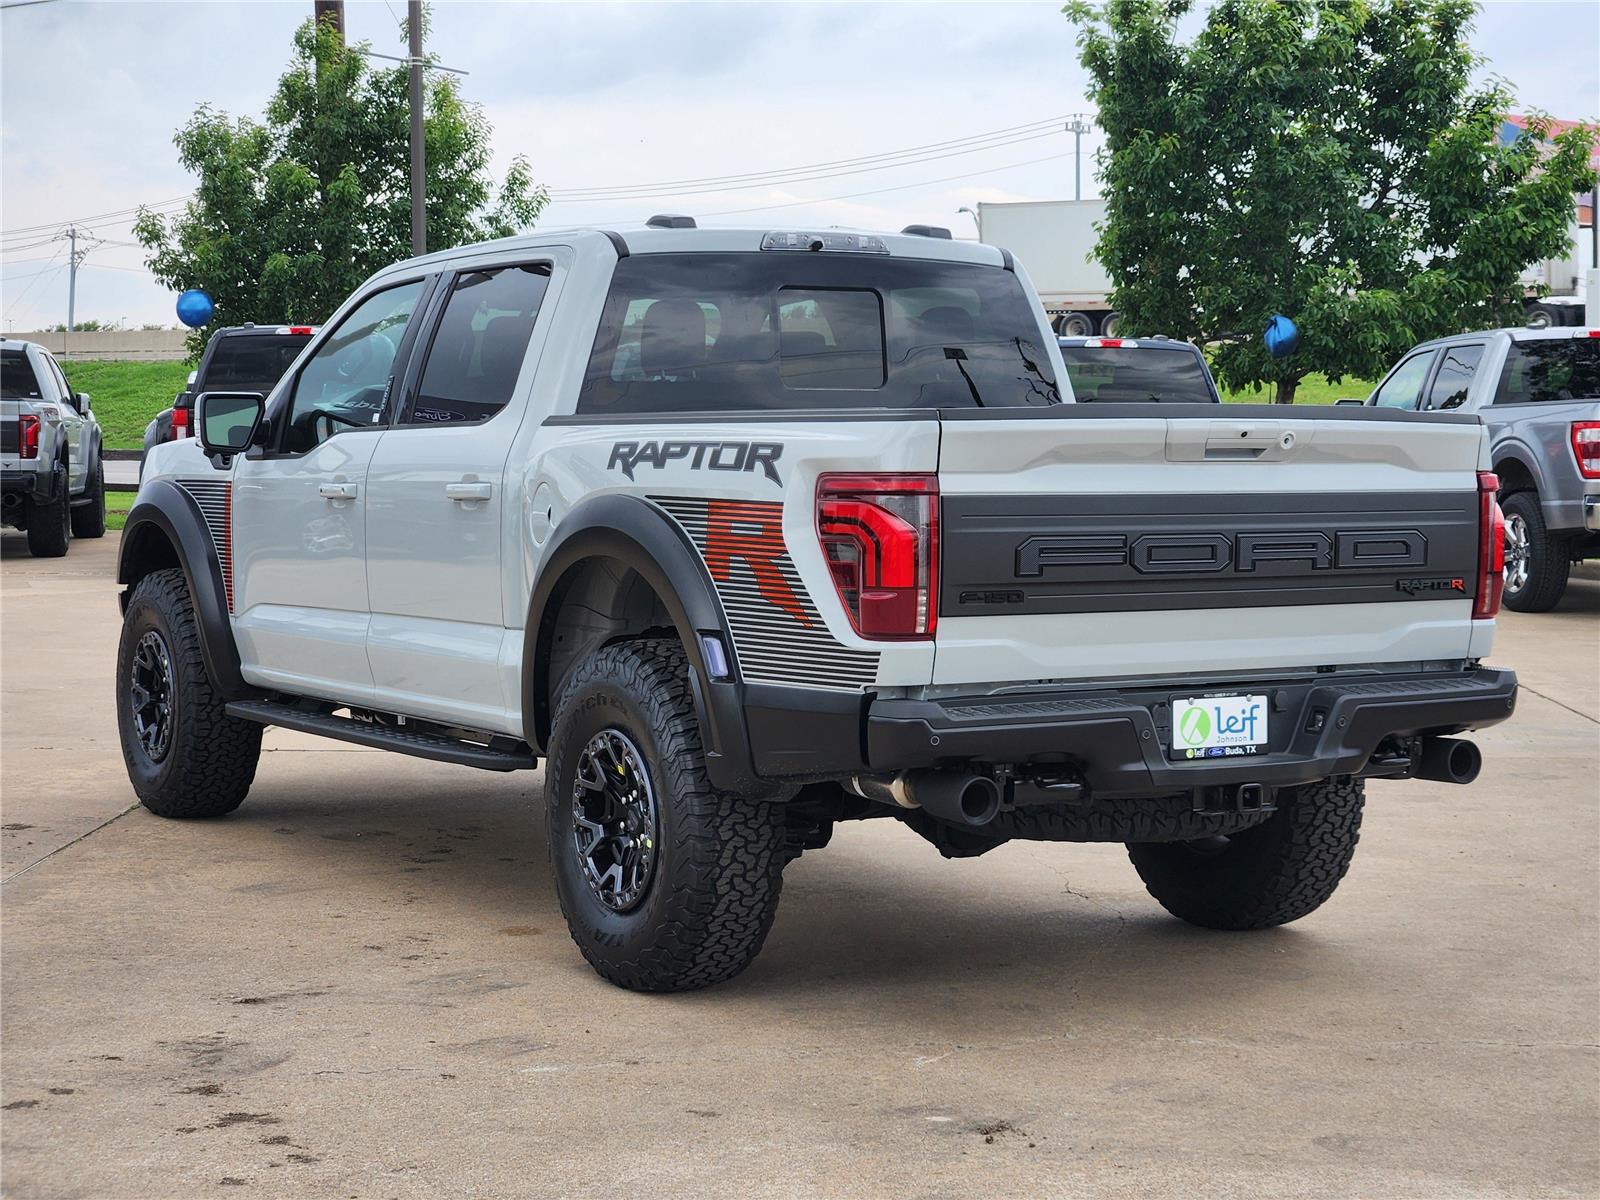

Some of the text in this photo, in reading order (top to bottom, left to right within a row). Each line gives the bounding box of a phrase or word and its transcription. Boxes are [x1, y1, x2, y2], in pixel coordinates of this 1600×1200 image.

[607, 441, 784, 488] RAPTOR
[1014, 529, 1428, 577] FORD
[1396, 577, 1466, 596] RAPTOR
[959, 590, 1025, 604] F-150
[1225, 747, 1245, 755] Buda,
[1246, 745, 1257, 753] TX
